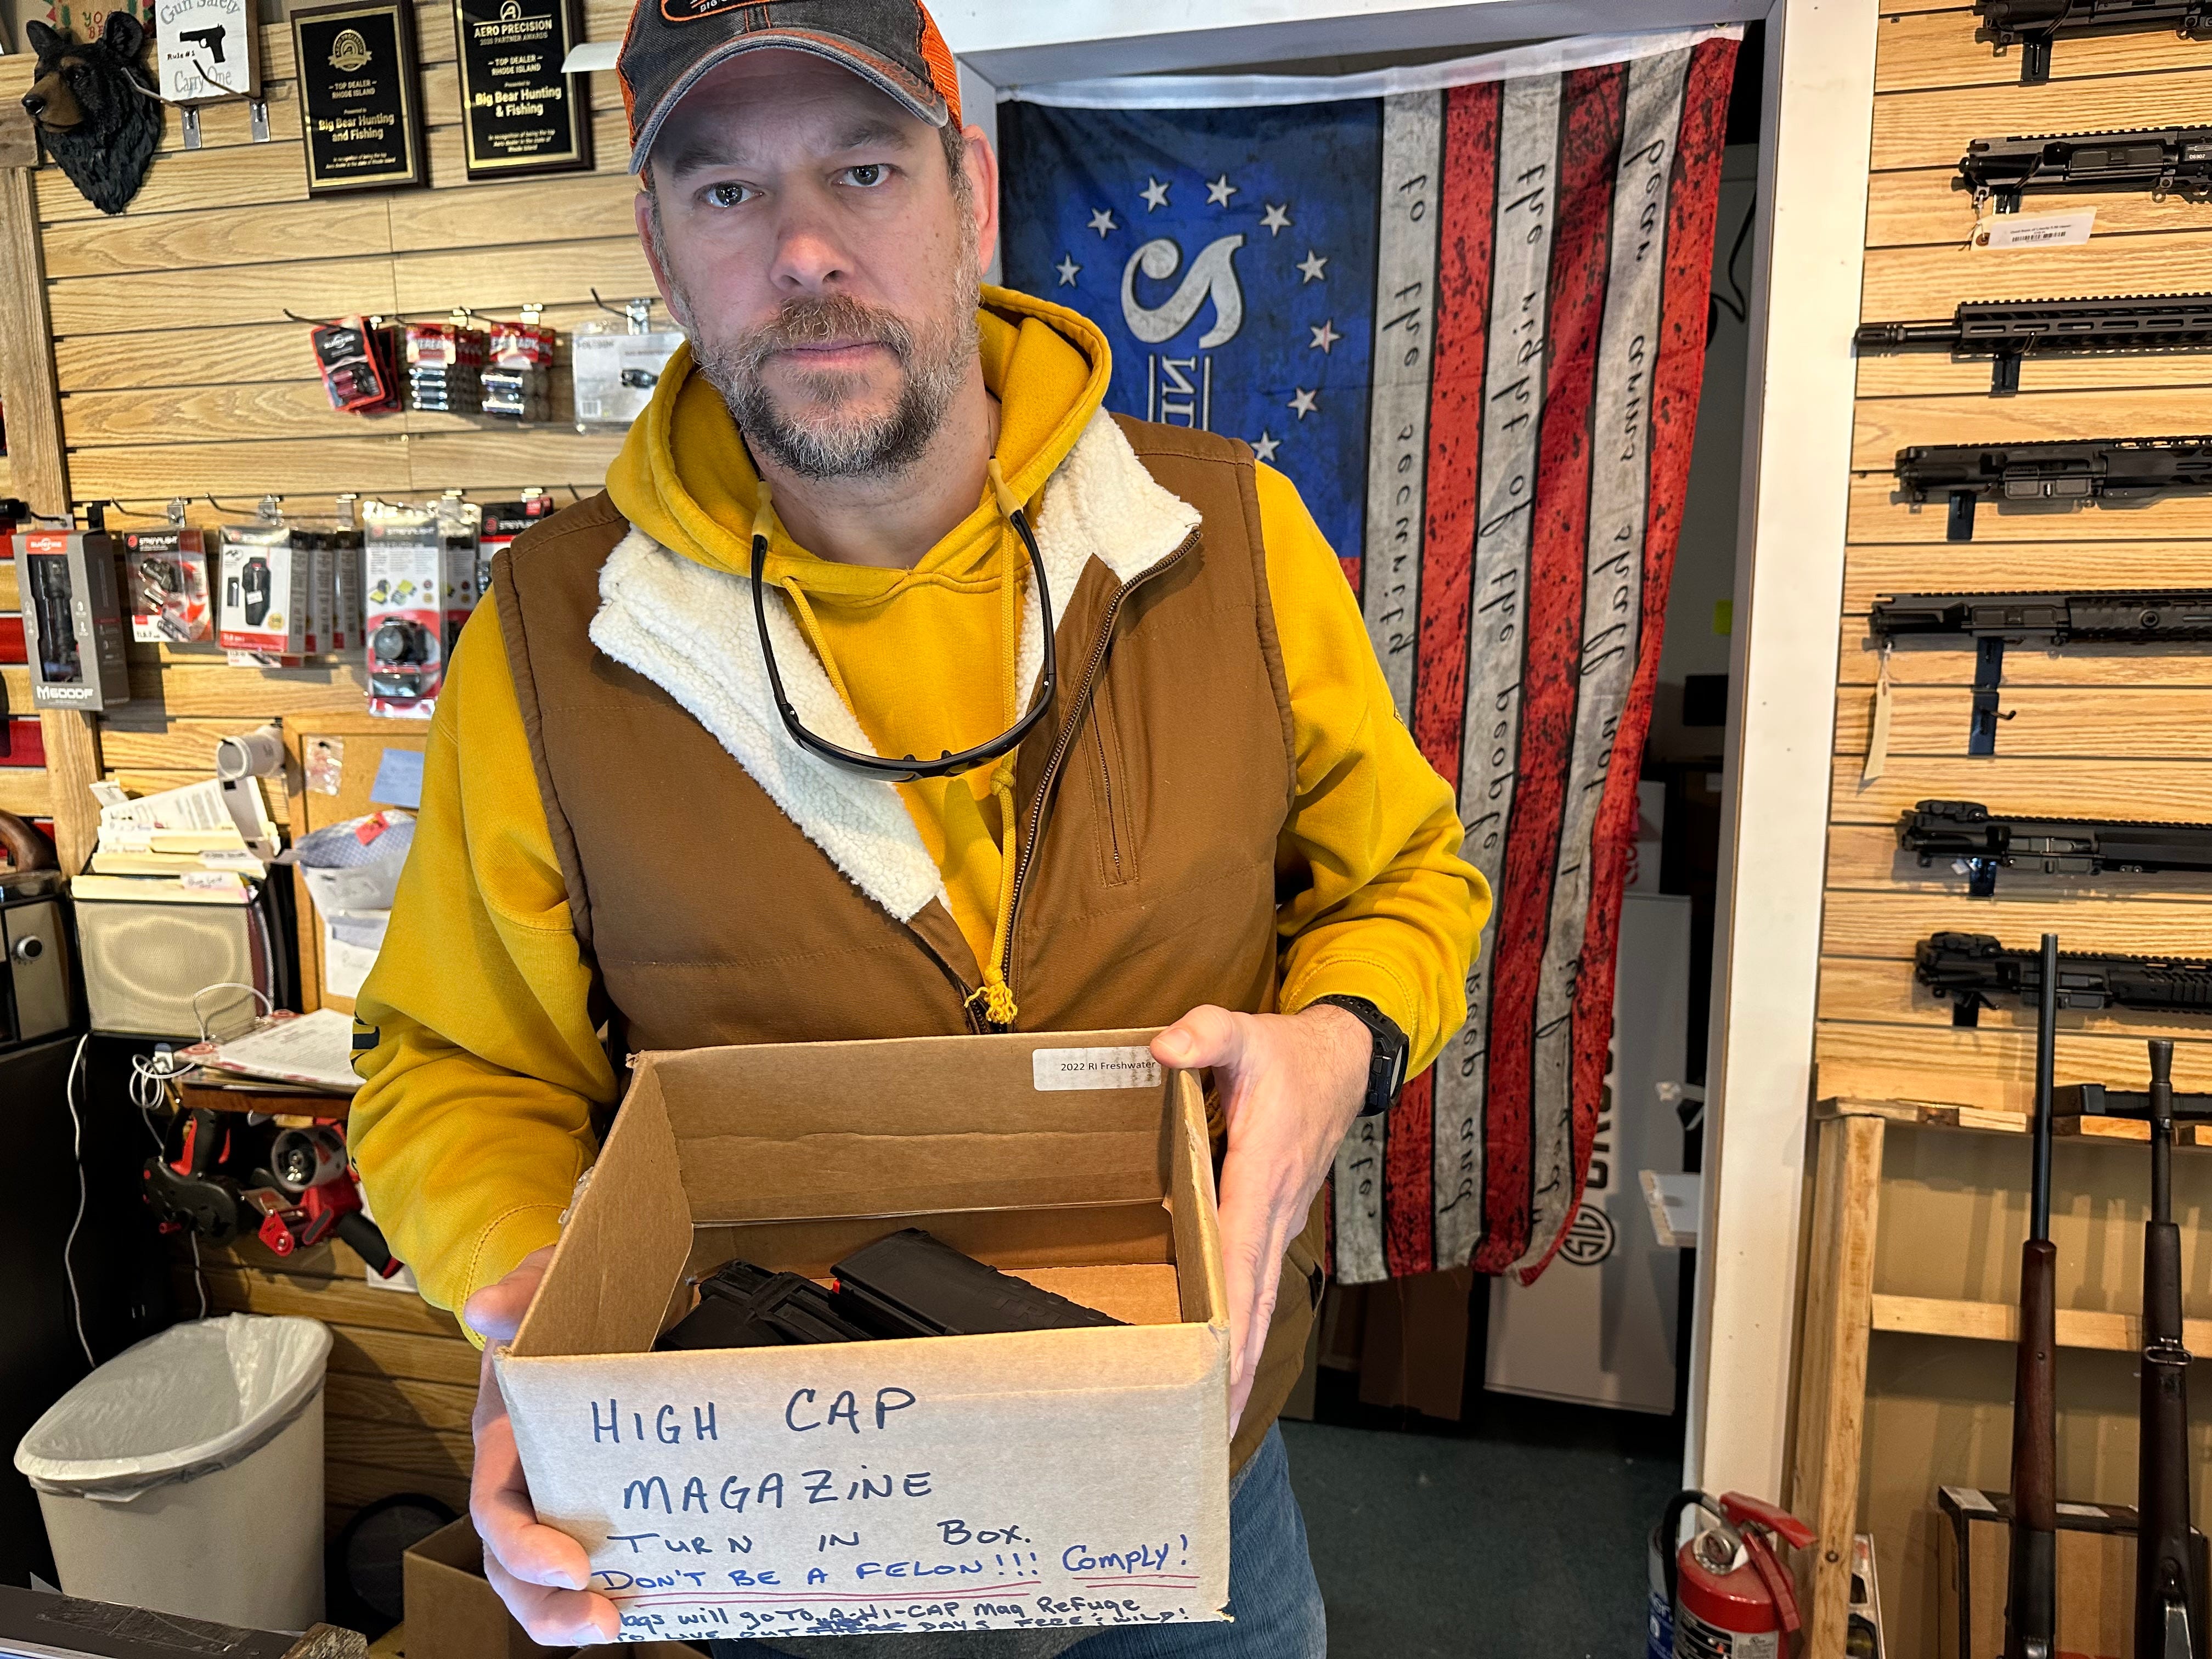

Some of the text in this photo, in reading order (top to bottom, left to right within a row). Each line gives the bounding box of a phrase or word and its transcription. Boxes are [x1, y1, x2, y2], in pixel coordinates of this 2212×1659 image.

[161, 0, 193, 25] Gun
[474, 19, 552, 38] AERO PRECISION
[495, 54, 536, 66] TOP DEALER
[516, 63, 541, 74] ISLAND
[174, 70, 204, 94] Carry
[475, 85, 562, 107] Big Bear Hunting
[495, 101, 544, 117] & Fishing
[318, 112, 394, 132] Big Bear Hunting
[332, 127, 384, 142] and Fishing
[1101, 1061, 1155, 1070] Freshwater
[591, 1387, 916, 1444] HIGH CAP
[607, 1533, 752, 1556] TURN
[819, 1531, 860, 1553] IN
[591, 1570, 706, 1590] DON'T
[728, 1570, 781, 1587] BE
[807, 1567, 828, 1585] A
[678, 1607, 729, 1624] will
[917, 1620, 991, 1631] DAYS
